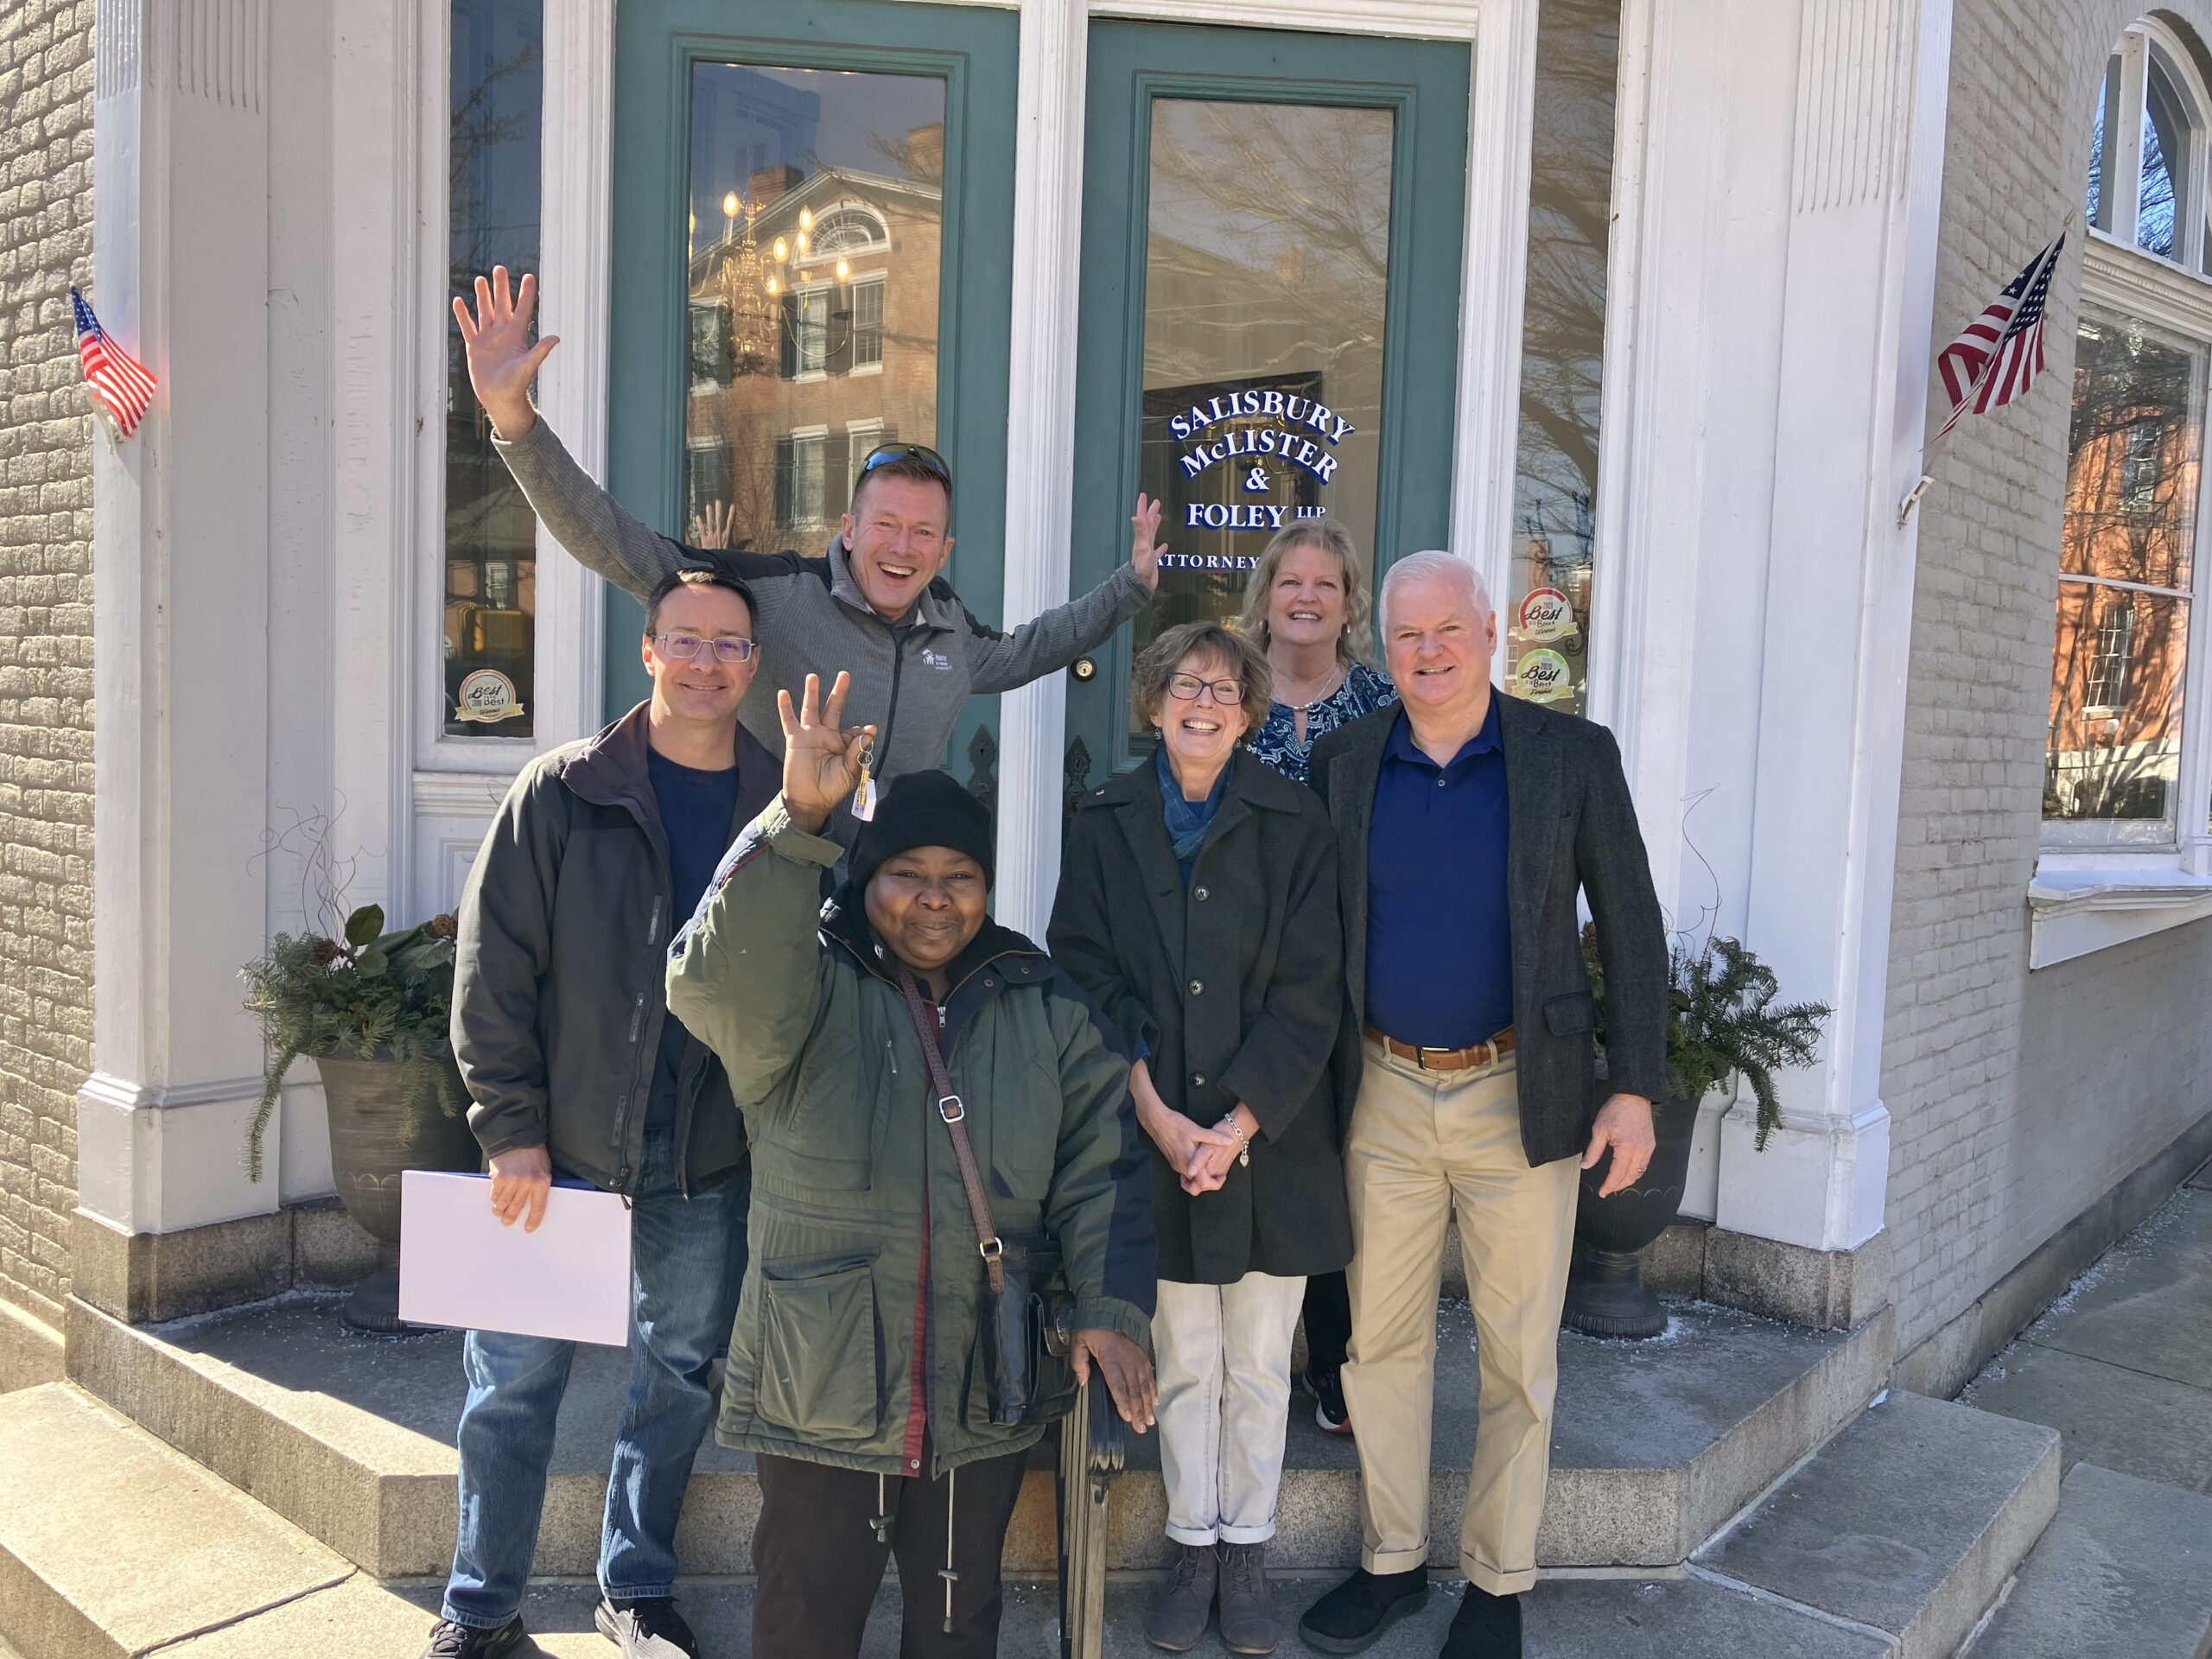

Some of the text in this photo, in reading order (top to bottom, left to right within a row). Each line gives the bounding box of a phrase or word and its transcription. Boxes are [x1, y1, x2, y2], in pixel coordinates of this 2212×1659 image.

[1169, 390, 1356, 445] SALISBURY
[1179, 429, 1338, 484] McLISTER
[1245, 467, 1270, 491] &
[1186, 503, 1326, 528] FOLEY LLP
[1525, 606, 1563, 620] Best
[1521, 666, 1560, 681] Best
[467, 685, 502, 699] Best
[484, 696, 505, 706] Best
